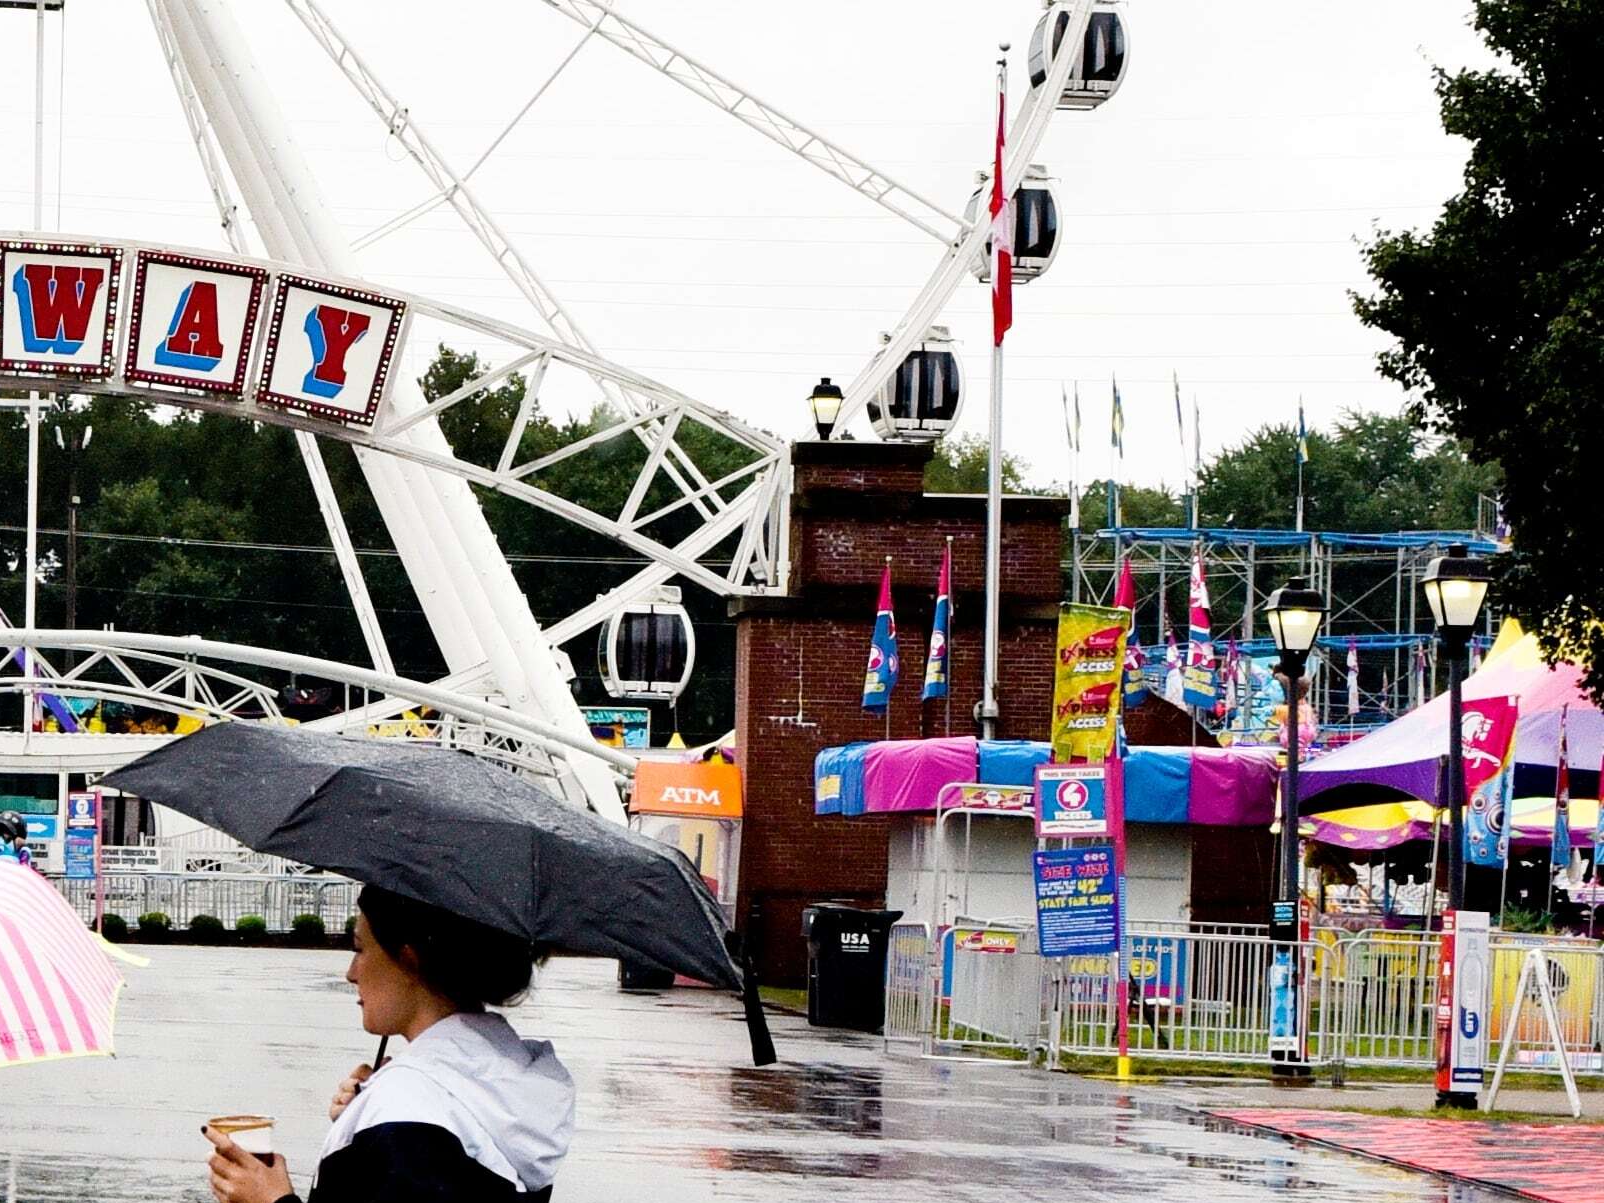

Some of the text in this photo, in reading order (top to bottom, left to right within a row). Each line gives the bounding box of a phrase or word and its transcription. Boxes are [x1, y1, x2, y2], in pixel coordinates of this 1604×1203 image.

[1073, 660, 1115, 673] ACCESS
[1067, 716, 1107, 729] ACCESS
[659, 787, 721, 806] ATM
[841, 933, 870, 945] USA
[1132, 945, 1154, 954] LOT
